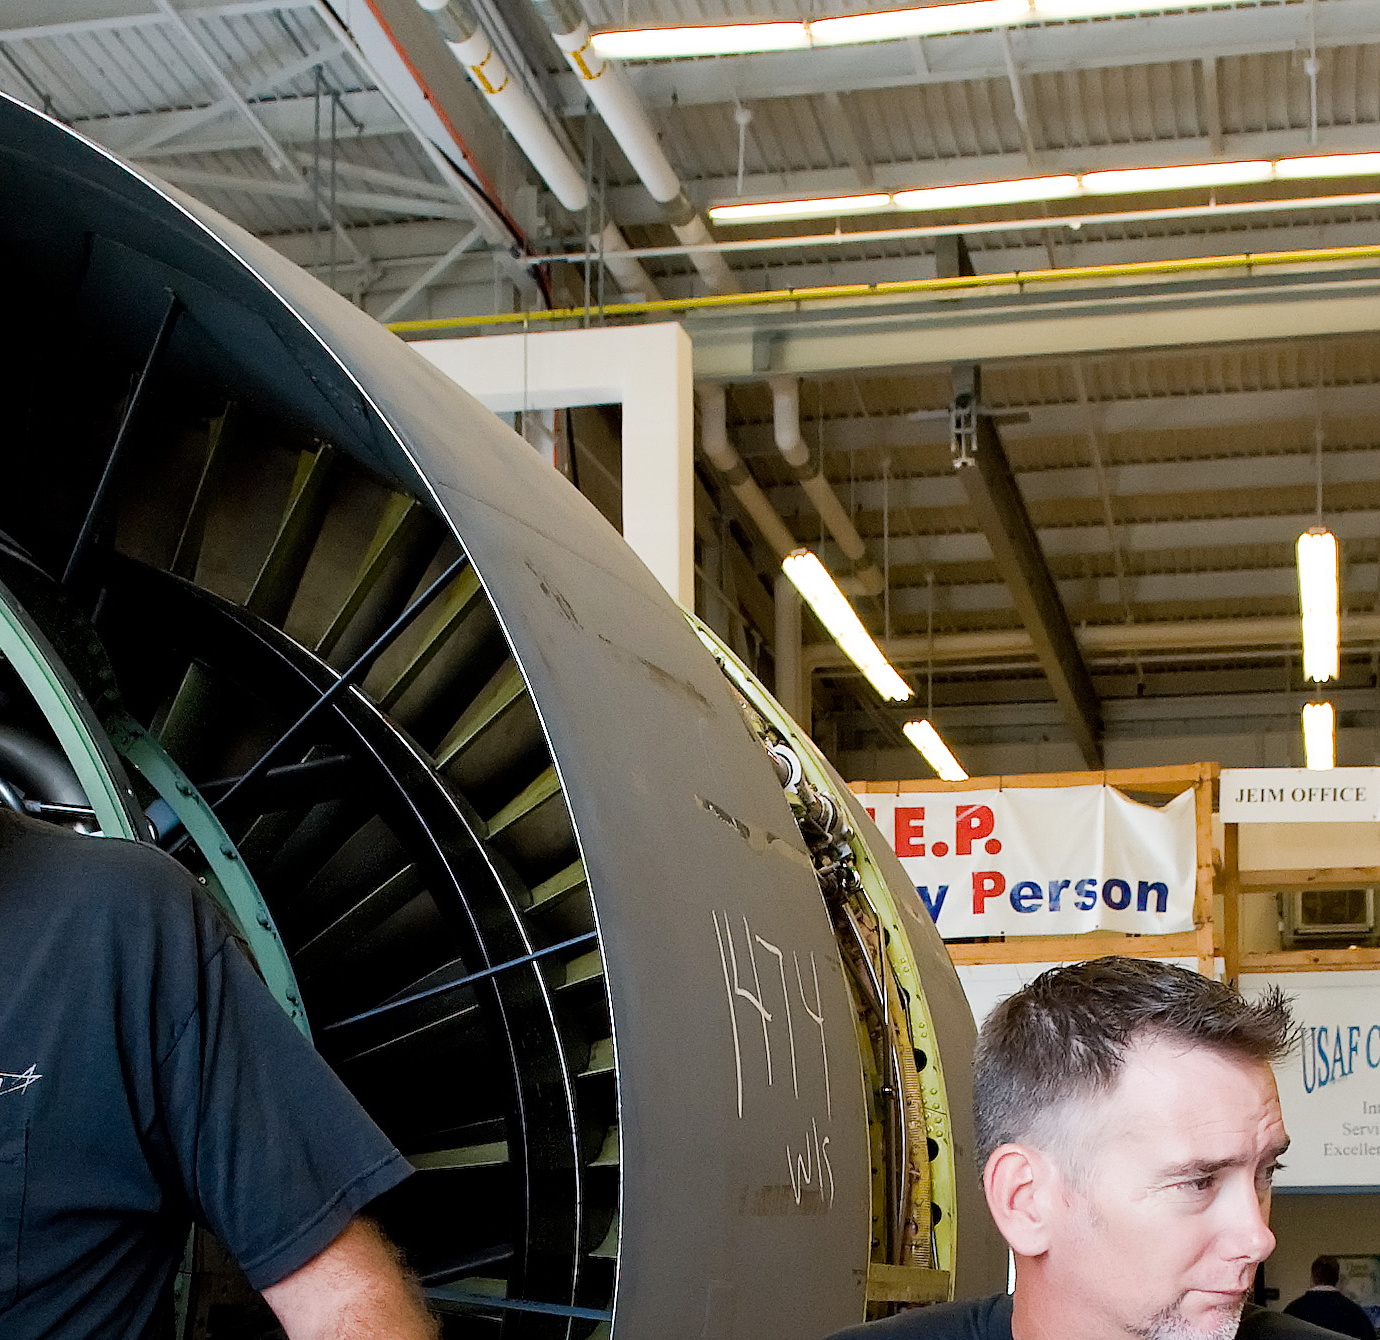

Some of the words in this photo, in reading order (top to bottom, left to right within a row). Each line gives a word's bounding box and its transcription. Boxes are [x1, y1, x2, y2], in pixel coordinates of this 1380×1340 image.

[1235, 788, 1284, 803] JEIM
[1292, 786, 1367, 803] OFFICE
[972, 870, 1169, 916] Person
[1301, 1026, 1361, 1094] USAF
